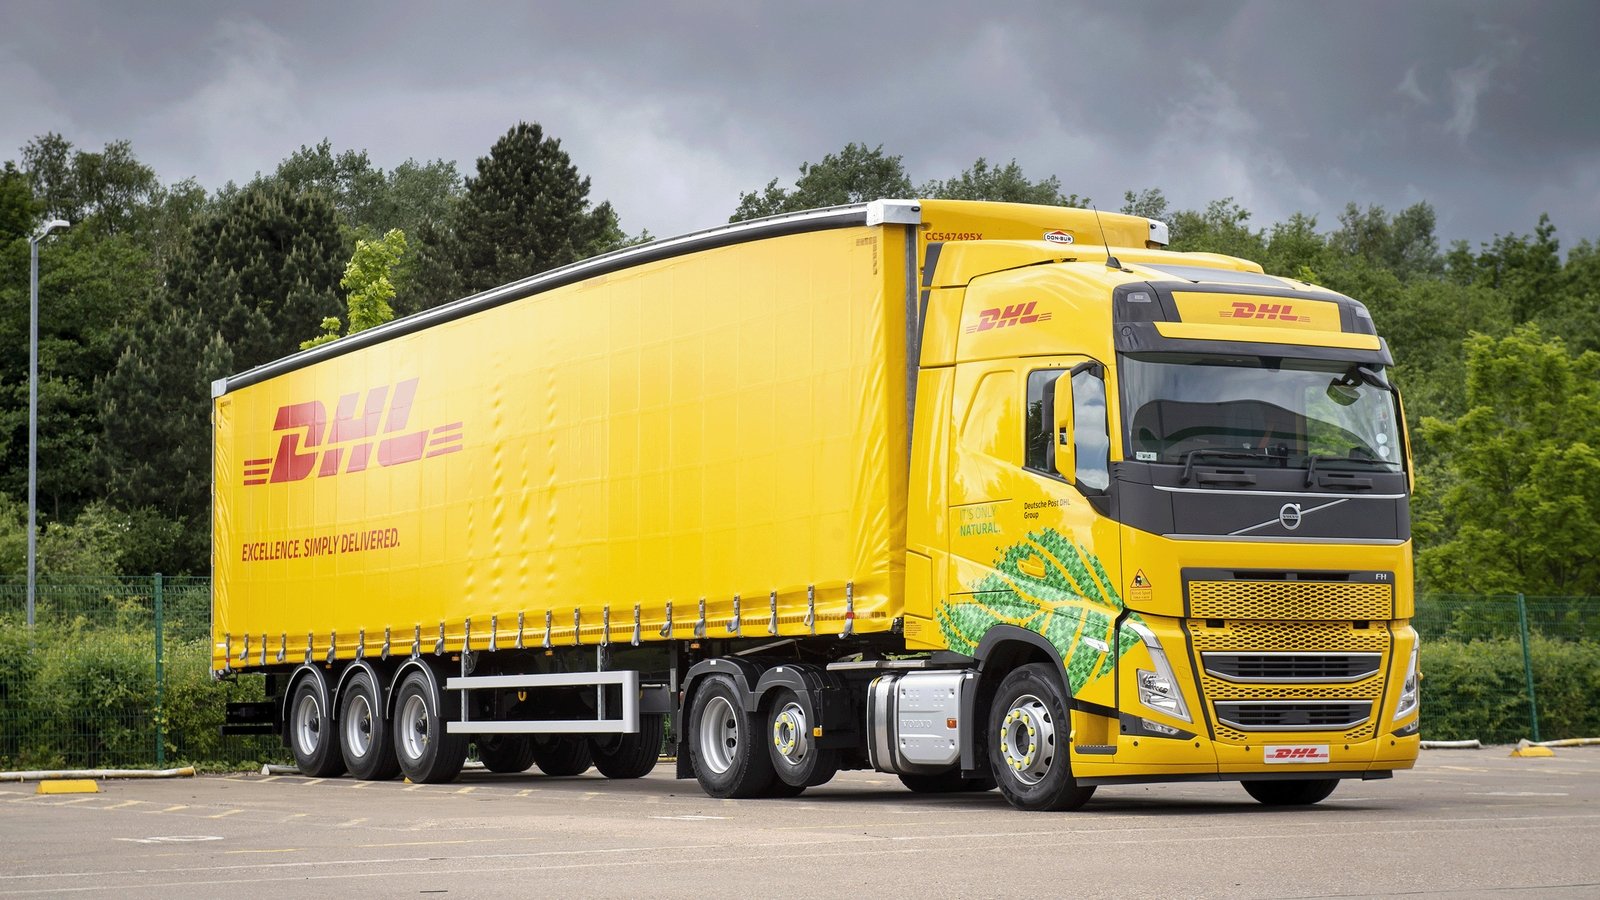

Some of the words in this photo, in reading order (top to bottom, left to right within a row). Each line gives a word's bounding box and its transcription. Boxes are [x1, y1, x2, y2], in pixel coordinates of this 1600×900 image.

[925, 232, 983, 241] CC547495X
[977, 301, 1039, 332] DHL
[1231, 302, 1298, 321] DHL
[268, 377, 430, 484] DHL
[1024, 500, 1047, 510] Deutsche
[1047, 500, 1059, 508] Post
[1059, 499, 1071, 507] DHL
[975, 505, 997, 519] ONLY
[1023, 511, 1039, 520] Group
[960, 522, 1001, 537] NATURAL.
[242, 539, 301, 562] EXCELLENCE.
[303, 534, 340, 558] SIMPLY
[341, 527, 401, 554] DELIVERED.
[1275, 747, 1320, 759] DHL
